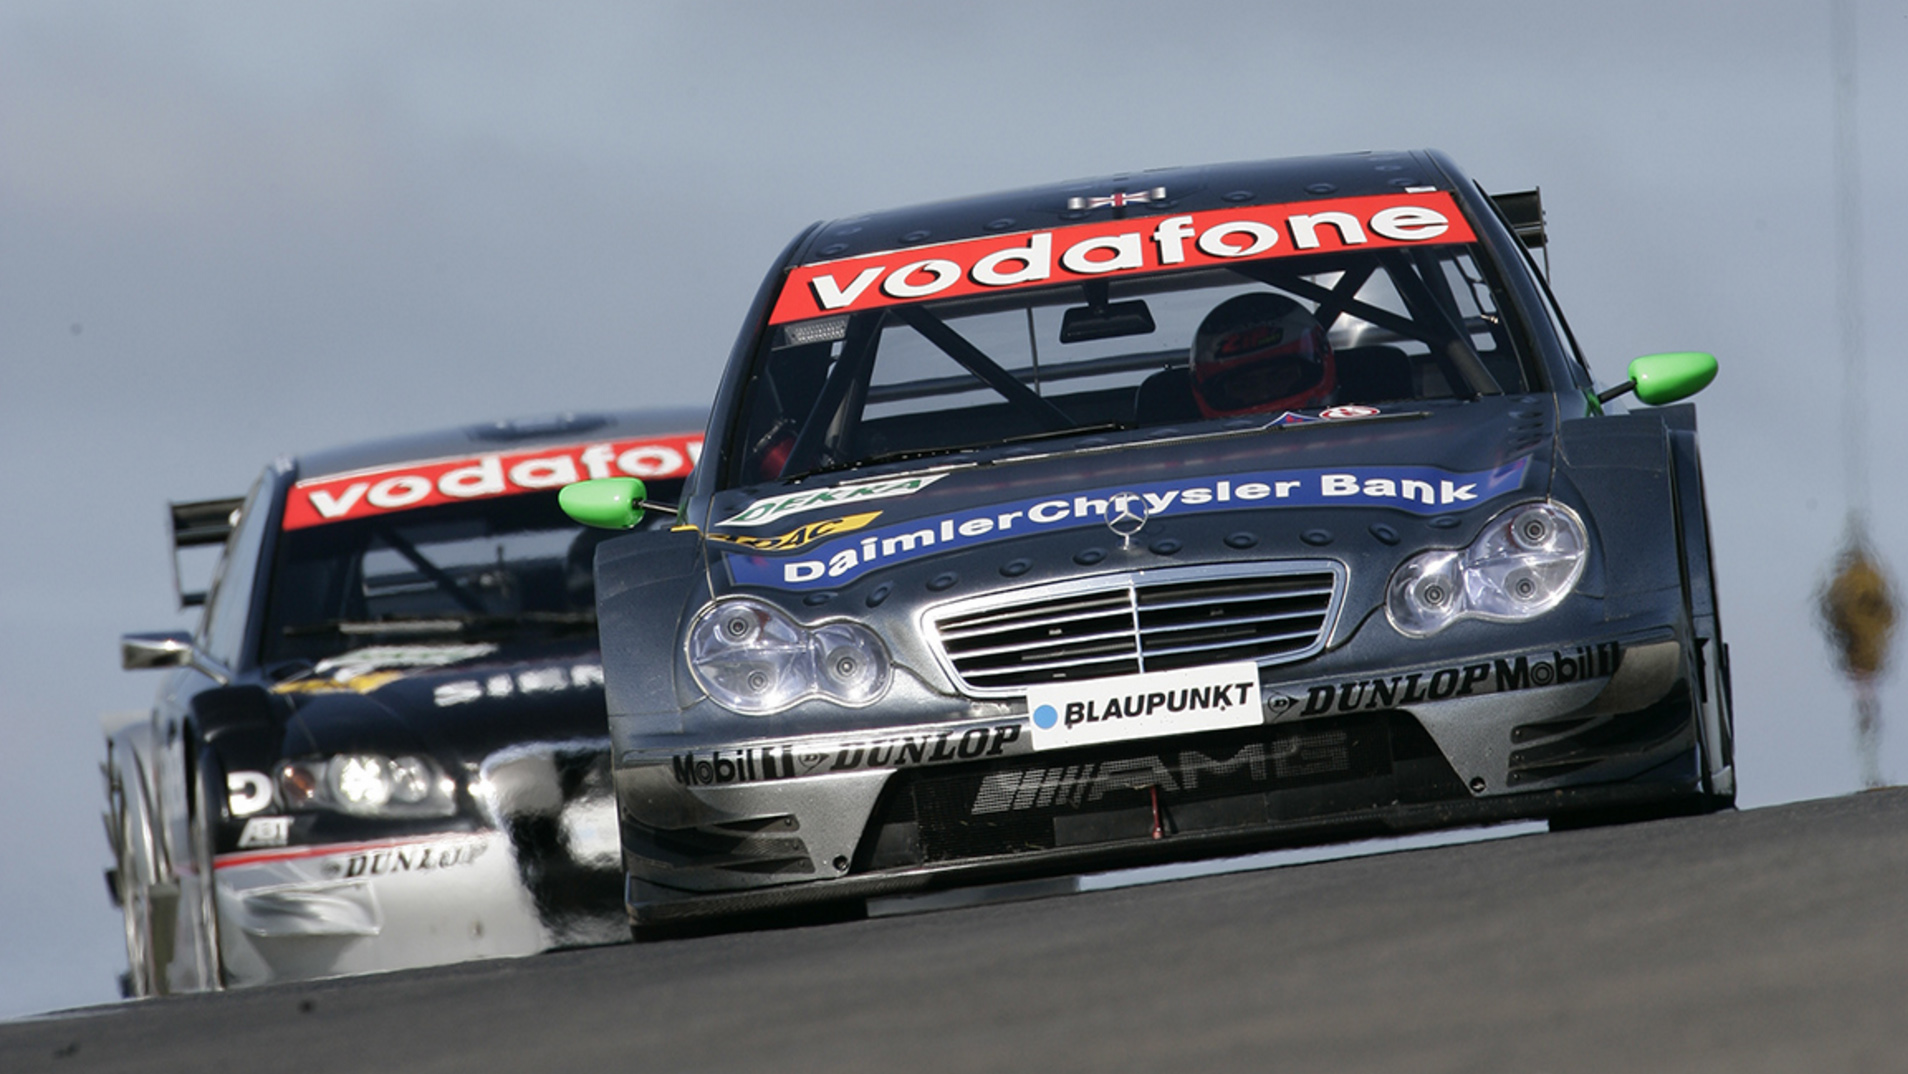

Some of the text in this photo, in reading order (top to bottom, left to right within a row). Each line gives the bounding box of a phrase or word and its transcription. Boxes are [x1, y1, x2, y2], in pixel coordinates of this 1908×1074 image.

[811, 205, 1450, 310] vodafone
[309, 442, 703, 519] vodafo
[784, 474, 1479, 583] DaimlerChrysler Bank
[1301, 662, 1492, 717] DUNLOP
[1494, 645, 1596, 692] Mobil
[1063, 682, 1254, 726] BLAUPUNKT
[672, 748, 757, 787] Mobil
[829, 724, 1023, 771] DUNLOP
